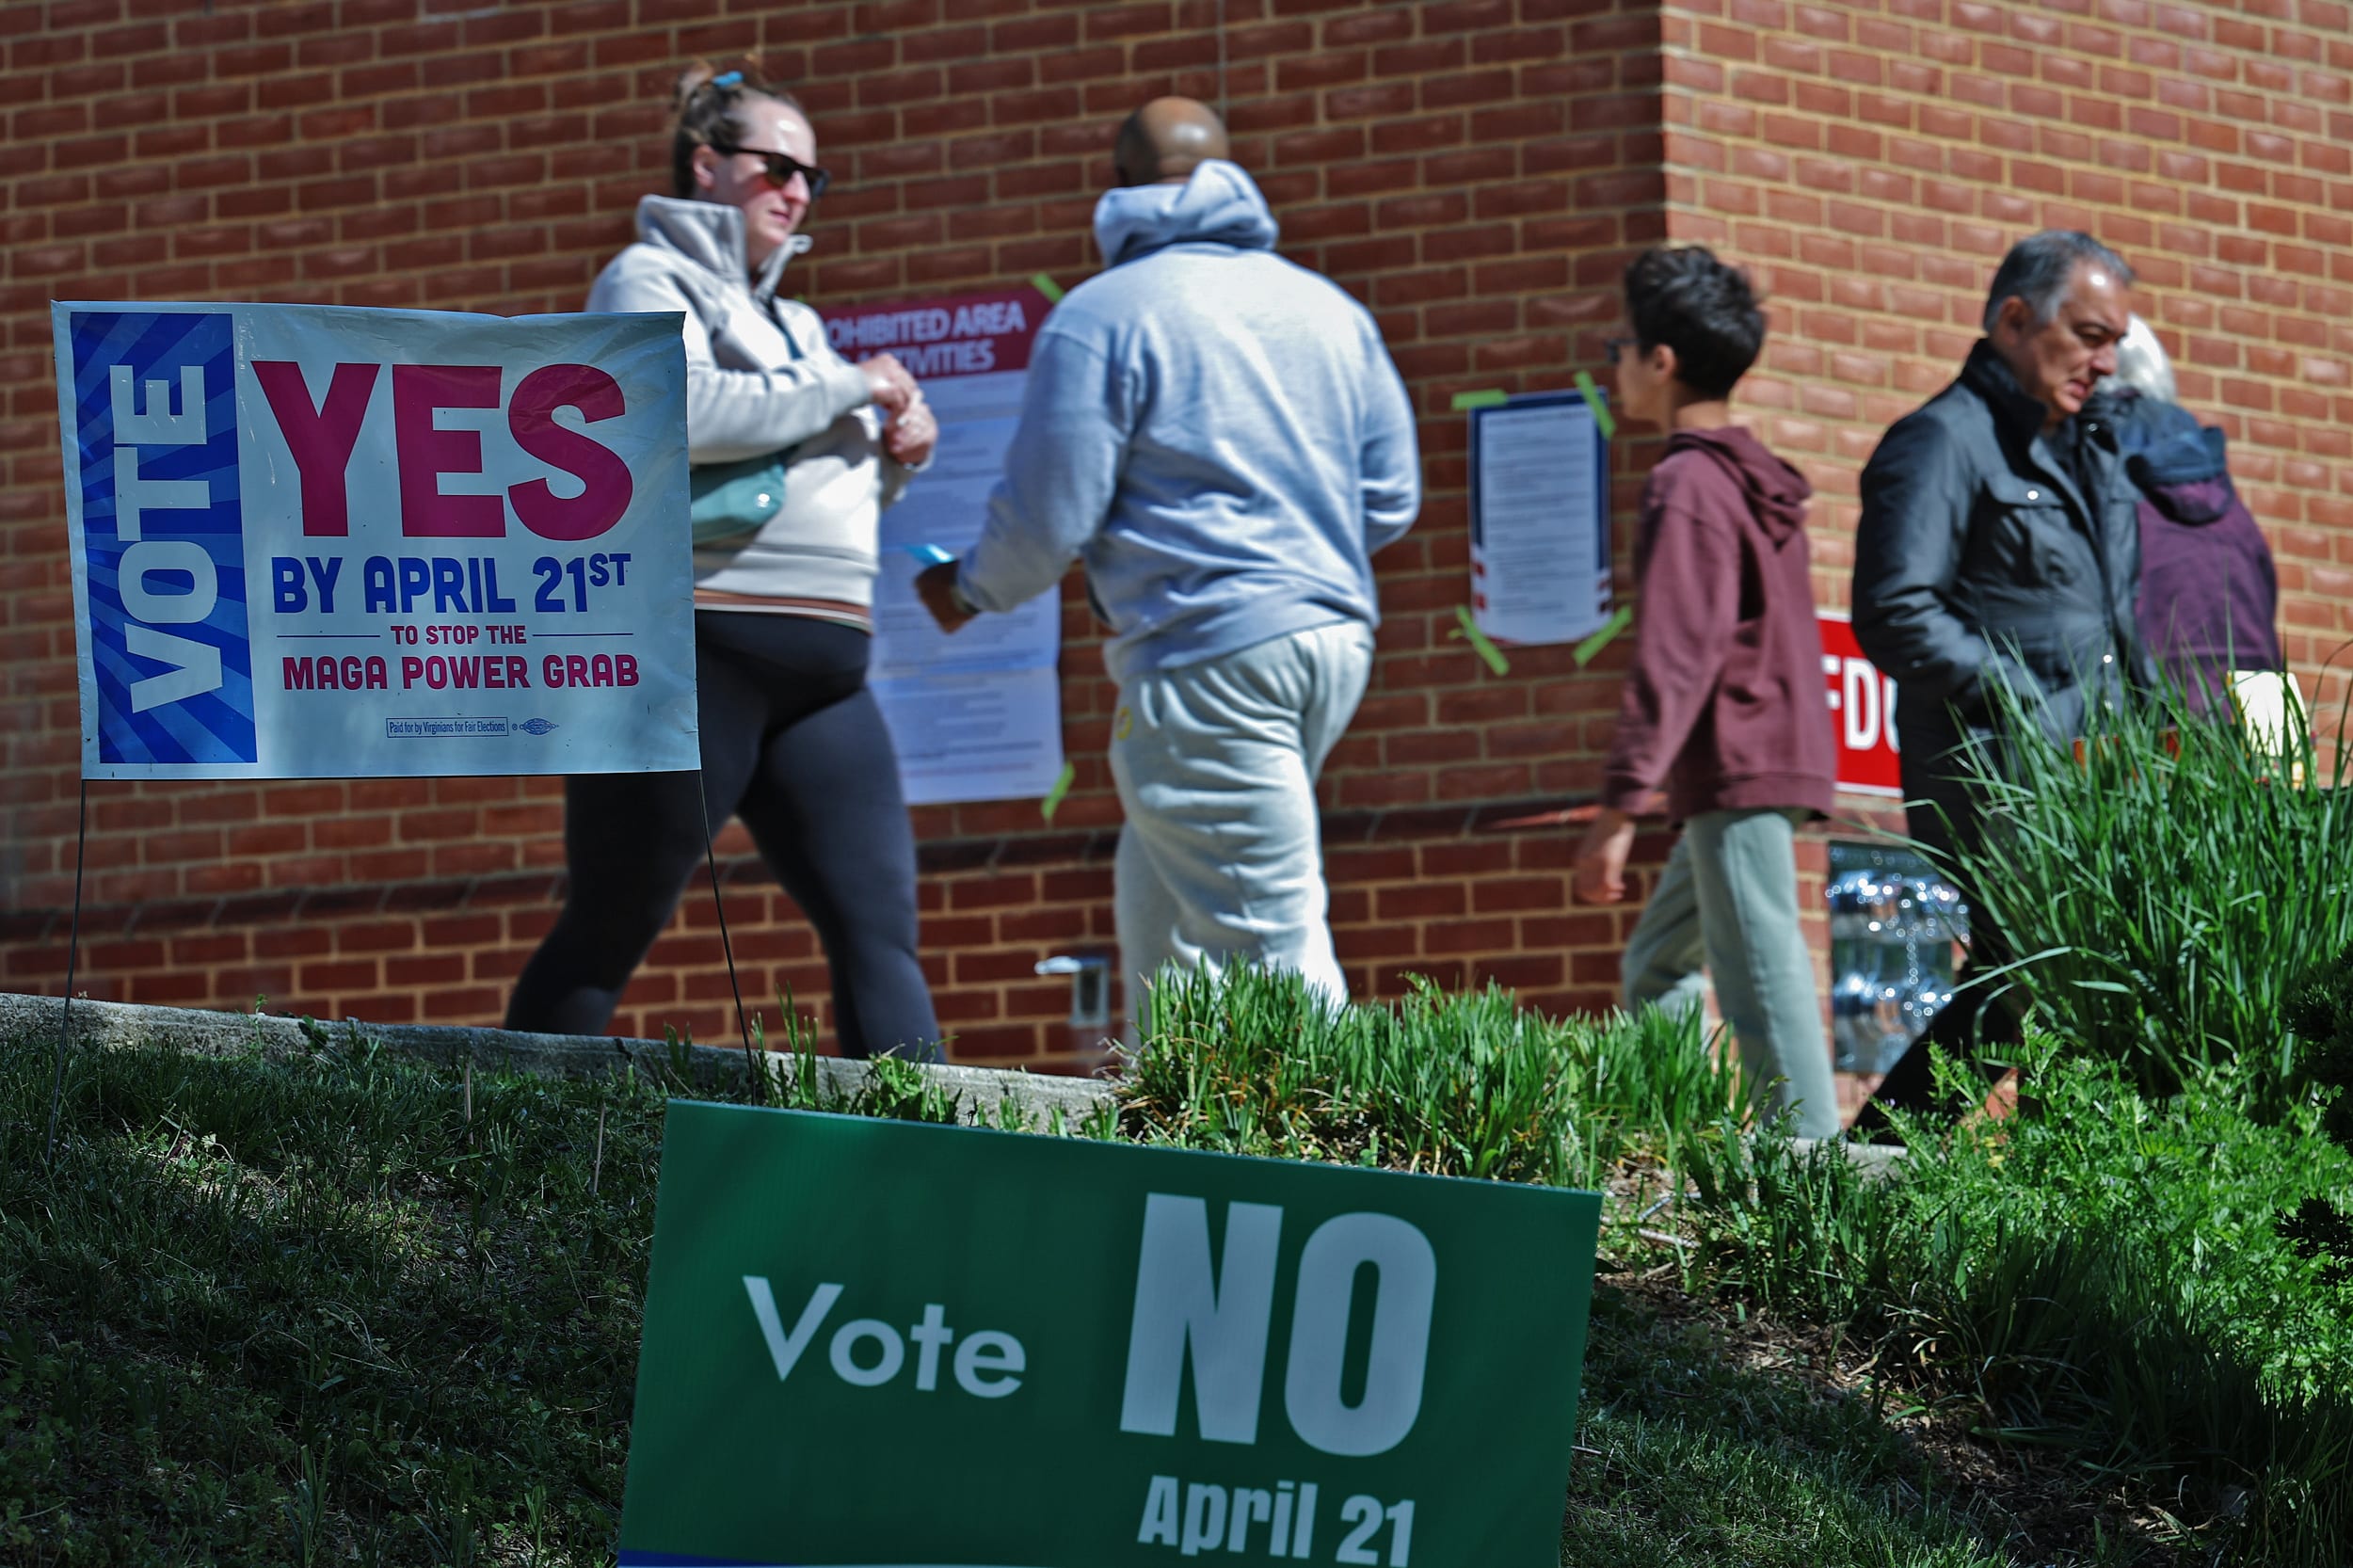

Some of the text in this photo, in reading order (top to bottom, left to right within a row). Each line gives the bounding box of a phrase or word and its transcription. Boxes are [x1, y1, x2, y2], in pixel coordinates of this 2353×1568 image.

[952, 300, 1026, 338] AREA
[250, 360, 633, 541] YES
[109, 364, 223, 713] VOTE
[272, 552, 632, 614] BY APRIL 21ST
[282, 654, 639, 691] MAGA POWER GRAB
[390, 625, 527, 645] TO STOP THE
[389, 721, 403, 733] Paid
[404, 721, 414, 733] for
[414, 721, 423, 735] by
[423, 721, 454, 734] Virginians
[455, 721, 464, 732] for
[465, 721, 476, 732] Fair
[477, 721, 506, 732] Elections
[744, 1276, 1026, 1400] Vote
[1120, 1192, 1437, 1457] NO
[1137, 1475, 1416, 1568] April 21
